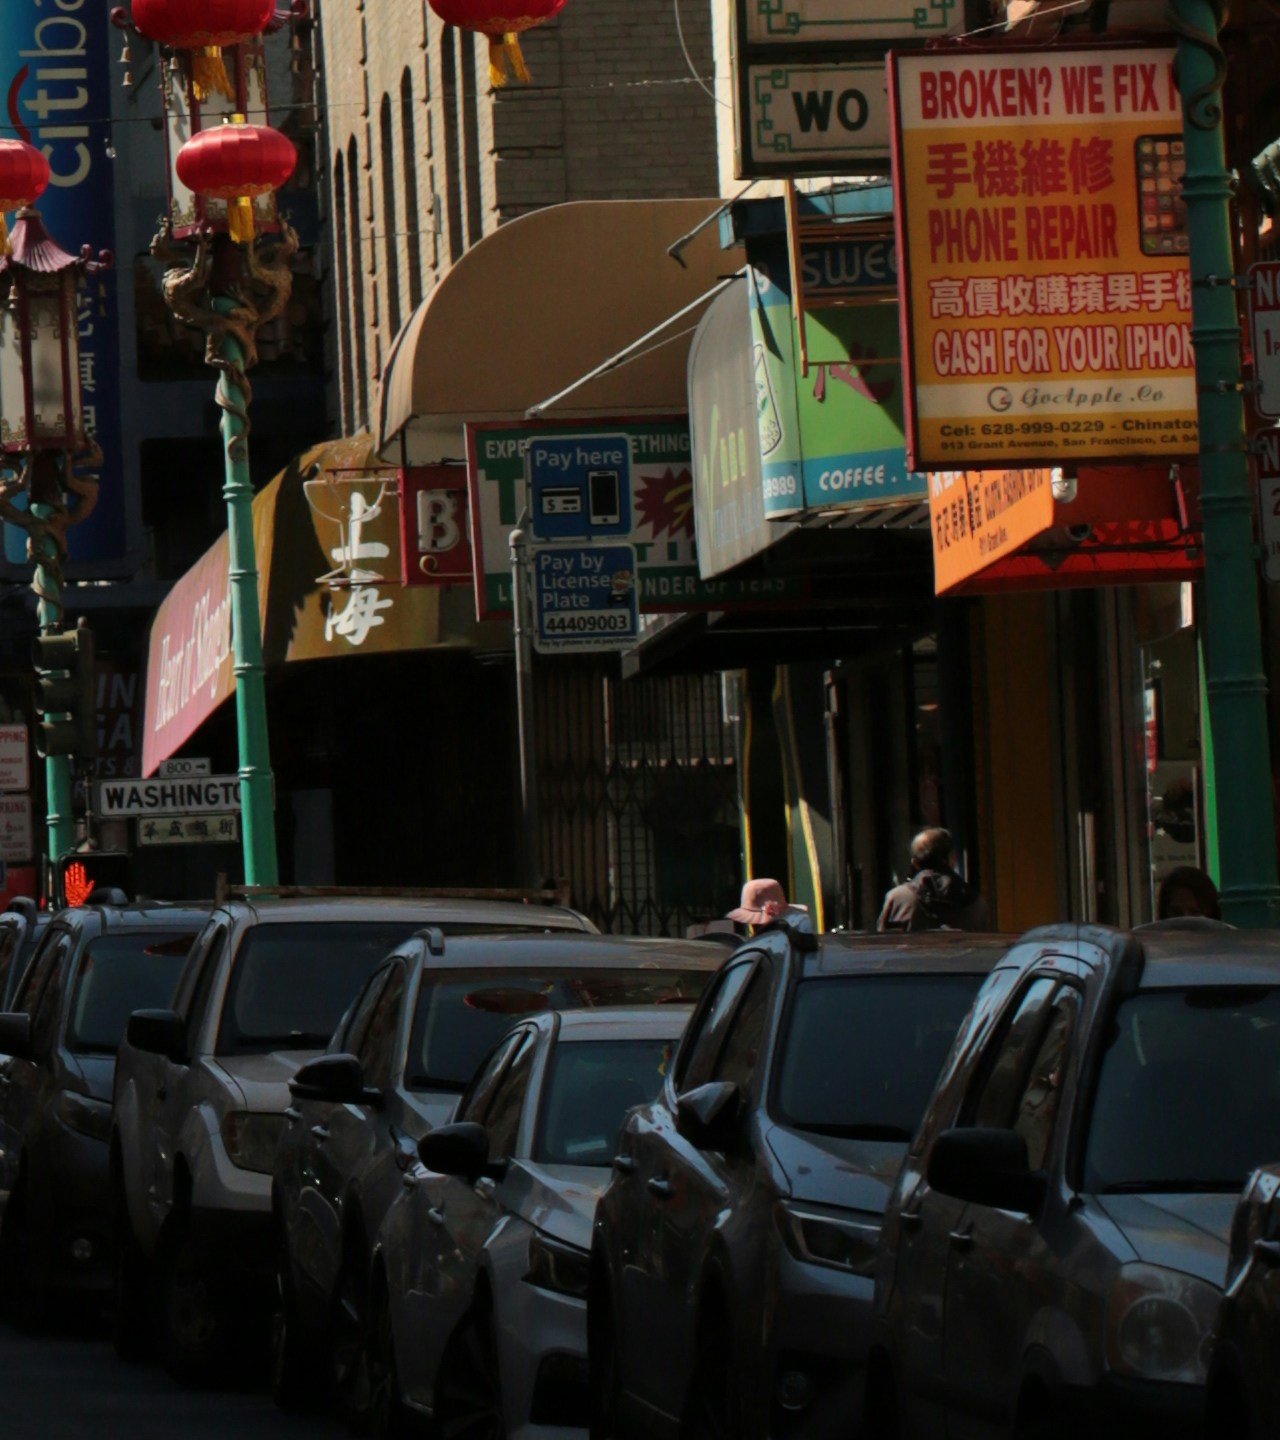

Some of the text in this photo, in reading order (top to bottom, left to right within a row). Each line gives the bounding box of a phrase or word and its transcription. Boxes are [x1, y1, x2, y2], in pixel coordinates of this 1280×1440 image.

[920, 65, 1159, 121] BROKEN? WE FIX
[792, 88, 869, 132] WO
[926, 136, 1117, 200] 手機維修
[929, 203, 1119, 264] PHONE REPAIR
[933, 320, 1196, 376] CASH FOR YOUR IPHON
[940, 423, 976, 438] Cel:
[1123, 418, 1198, 432] Chinato
[535, 446, 625, 471] Pay here
[819, 464, 886, 491] COFFEE
[541, 553, 605, 574] Pay by
[542, 572, 611, 590] License
[543, 592, 591, 609] Plate
[546, 615, 628, 633] 44409003
[166, 761, 192, 774] 800
[104, 783, 242, 810] WASHINGTO
